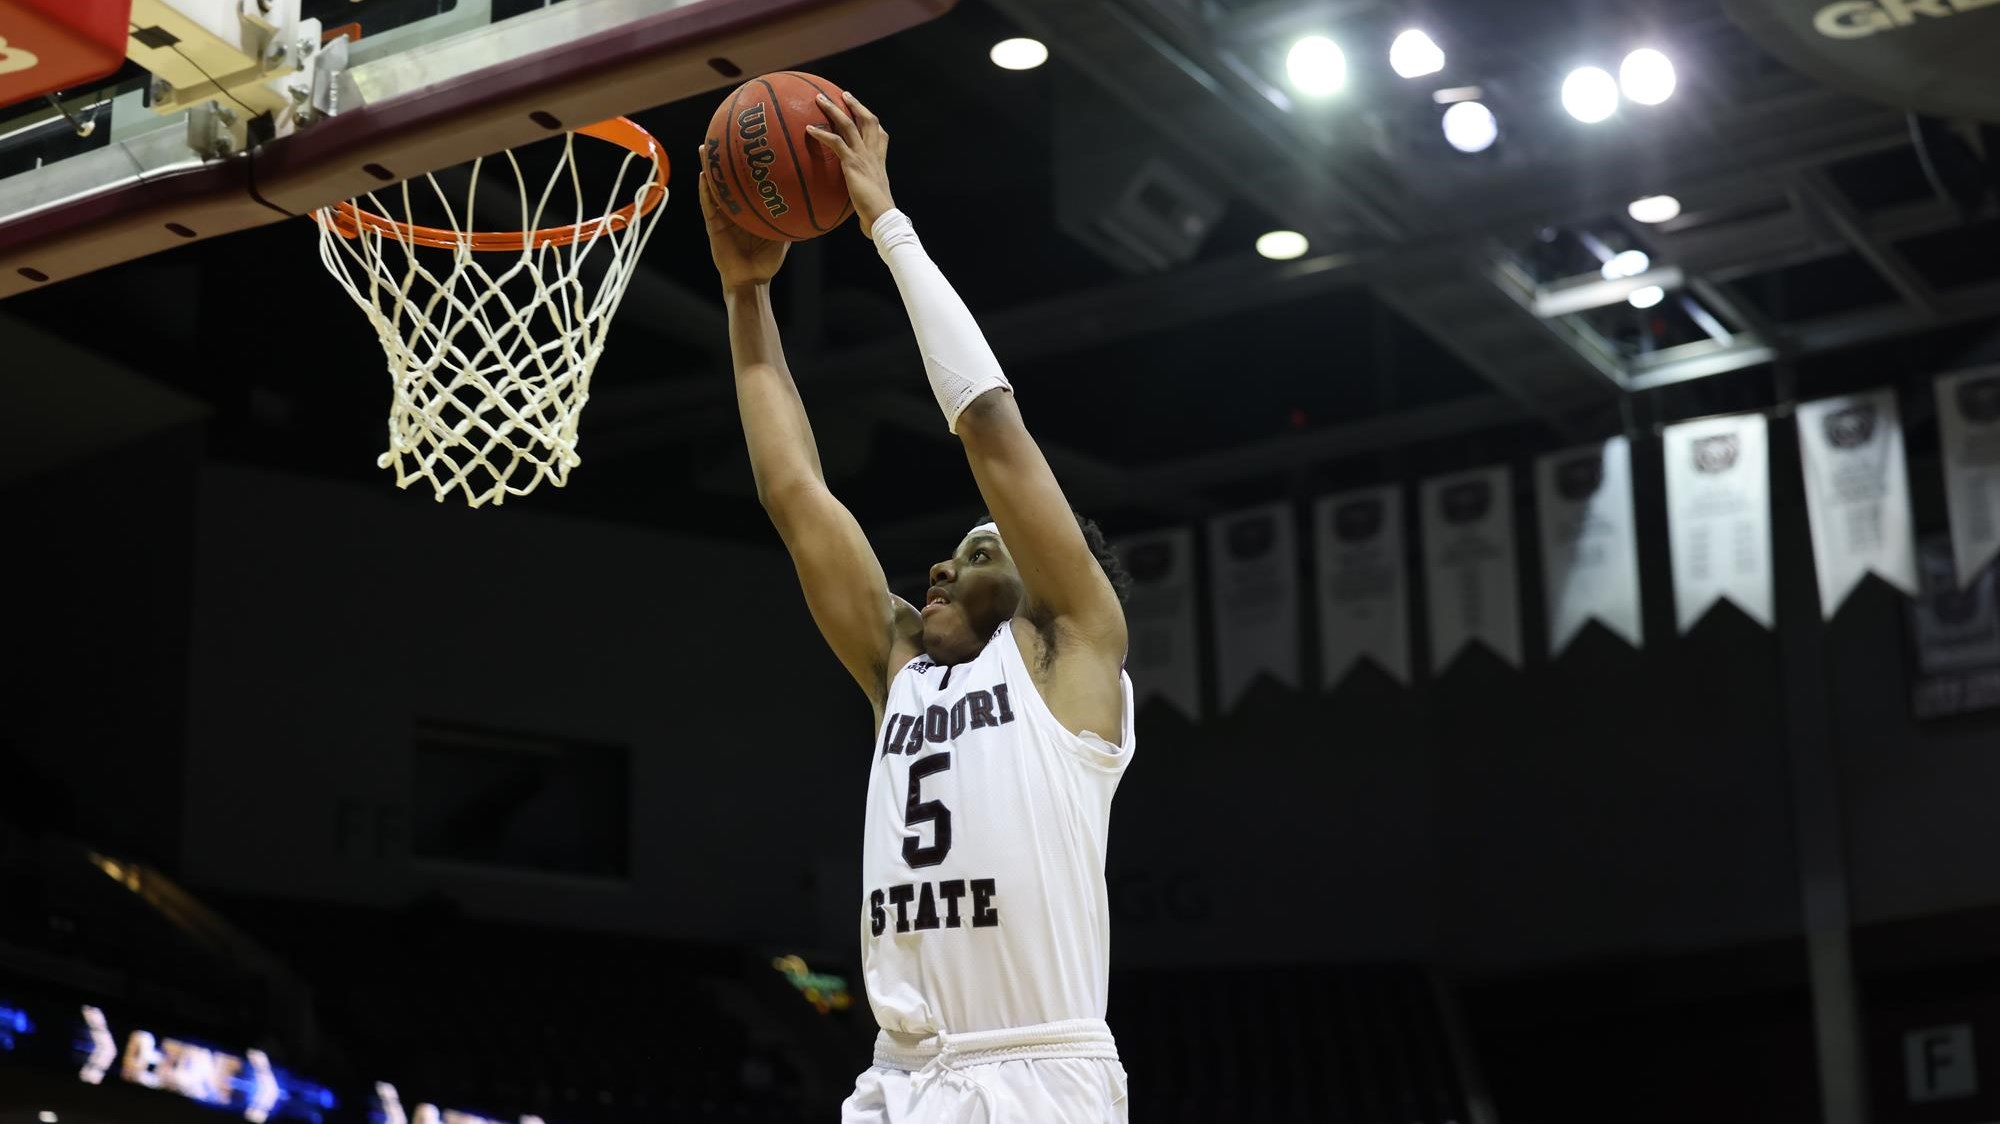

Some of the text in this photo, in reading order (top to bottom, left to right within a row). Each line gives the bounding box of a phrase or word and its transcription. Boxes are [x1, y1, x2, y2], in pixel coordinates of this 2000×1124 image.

[1812, 0, 2000, 40] GR
[737, 102, 789, 219] Wilson
[901, 751, 952, 870] 5
[870, 878, 999, 938] STATE
[1924, 1036, 1953, 1090] F
